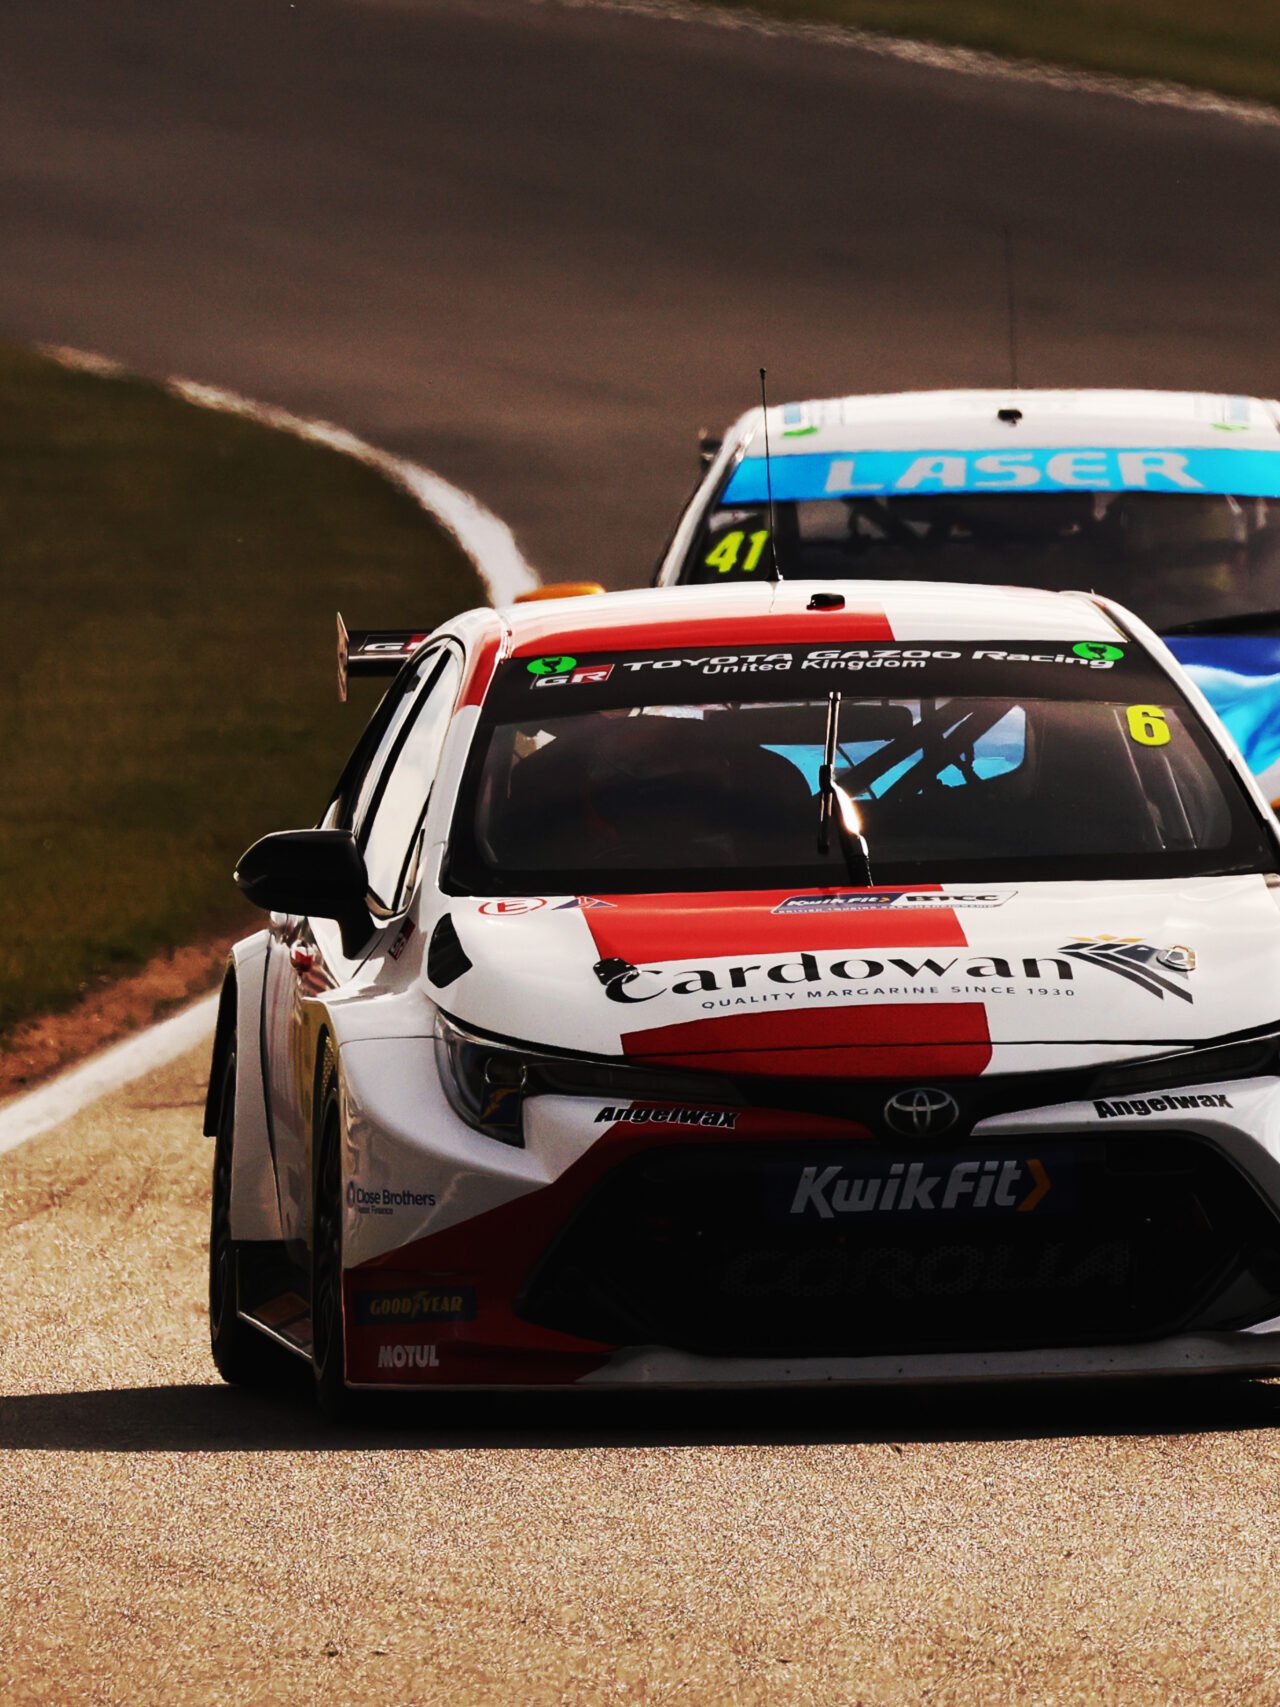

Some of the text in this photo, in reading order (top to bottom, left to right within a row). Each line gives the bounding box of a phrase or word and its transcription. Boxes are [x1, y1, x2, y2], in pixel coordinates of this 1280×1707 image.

[825, 451, 1205, 492] LASER
[704, 529, 769, 573] 41
[622, 649, 1115, 672] TOYOTA GAZOO Racing
[702, 657, 927, 676] United Kingdom
[534, 670, 609, 688] GR
[1125, 704, 1172, 747] 6
[605, 953, 1074, 1004] Cardowan
[701, 985, 1075, 1009] QUALITY MARGARINE SINCE 1930
[593, 1106, 740, 1130] Angelwax
[1092, 1094, 1235, 1119] Angelwax
[382, 1189, 437, 1207] Brothers
[377, 1344, 440, 1369] MOTUL
